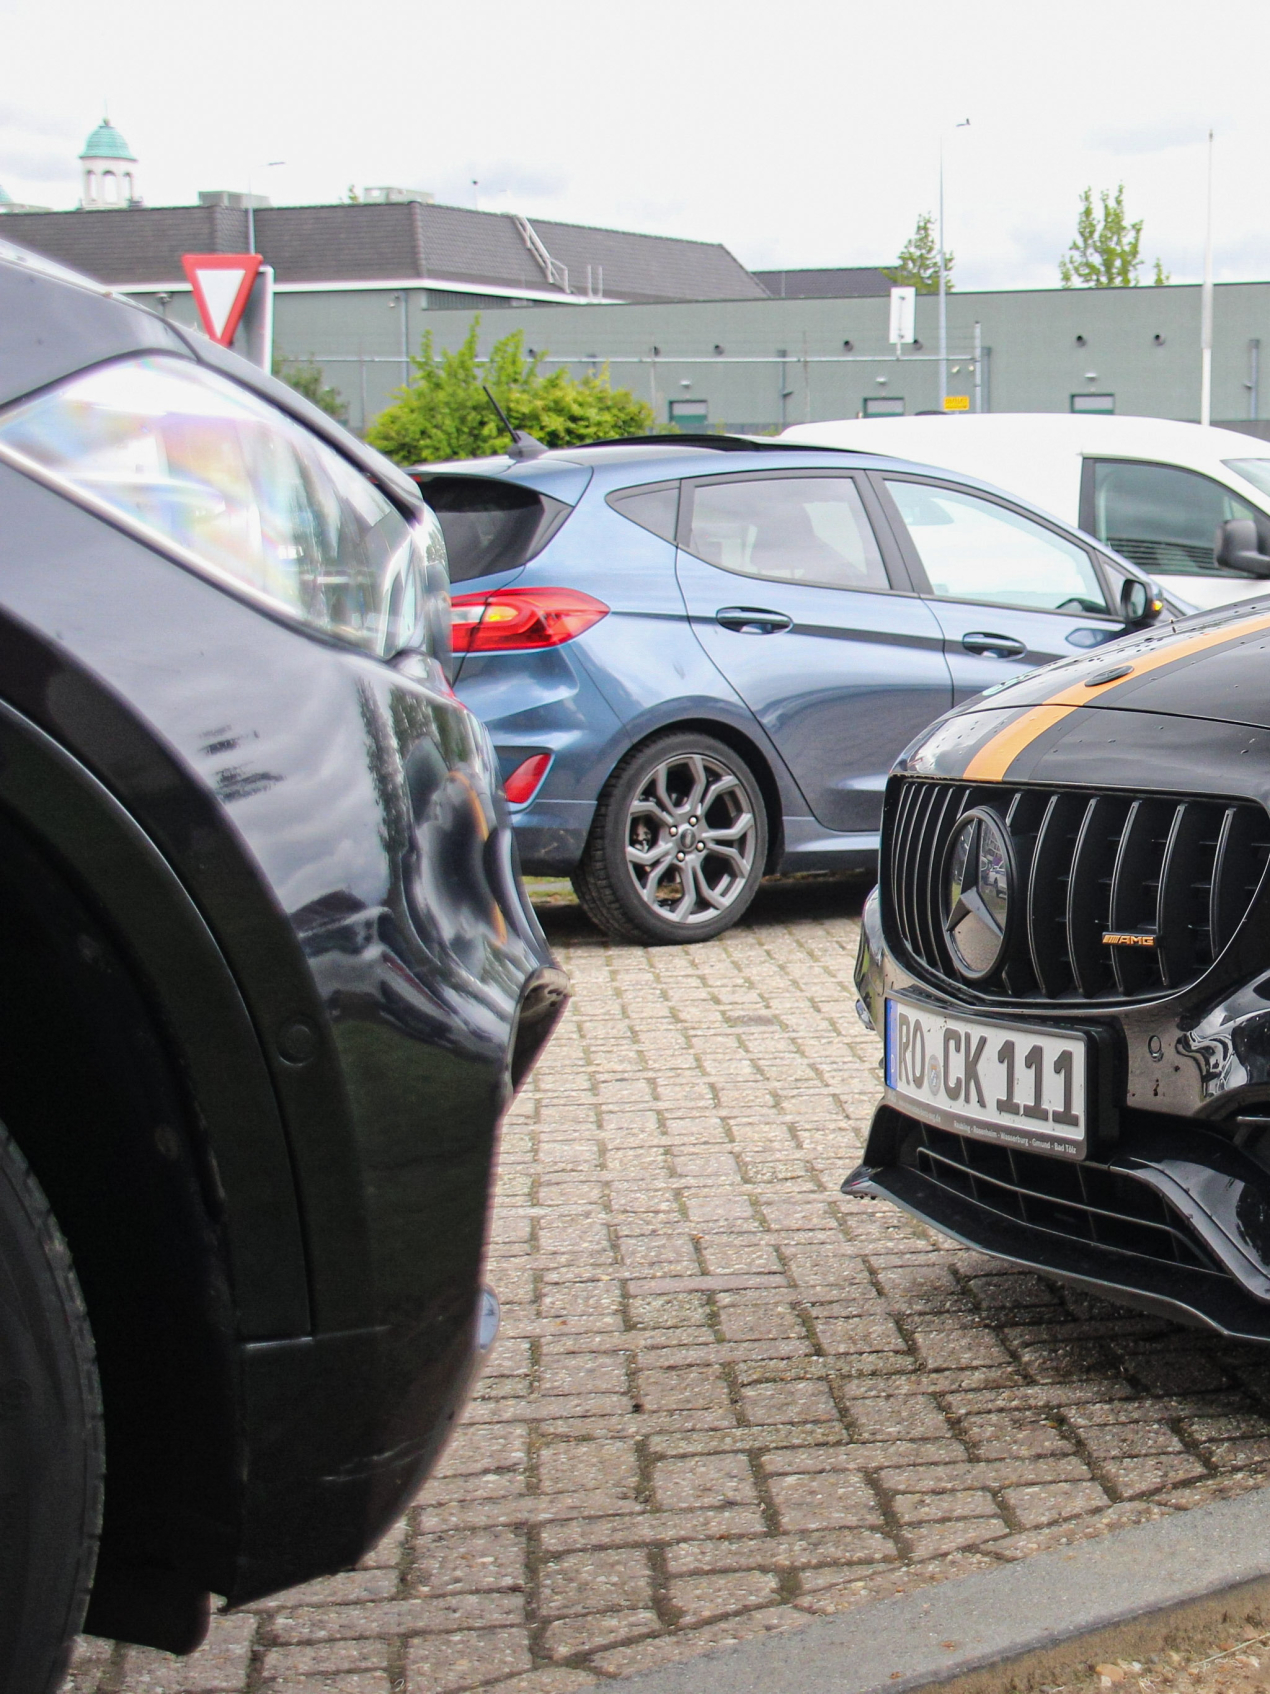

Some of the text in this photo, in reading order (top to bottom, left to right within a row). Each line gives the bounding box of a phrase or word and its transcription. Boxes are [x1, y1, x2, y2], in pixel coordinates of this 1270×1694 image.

[1117, 934, 1155, 947] AMG
[898, 1012, 1079, 1127] RO CK 111
[1032, 1138, 1051, 1150] Gmund
[1054, 1142, 1065, 1152] Bad
[1065, 1144, 1077, 1155] Tölz
